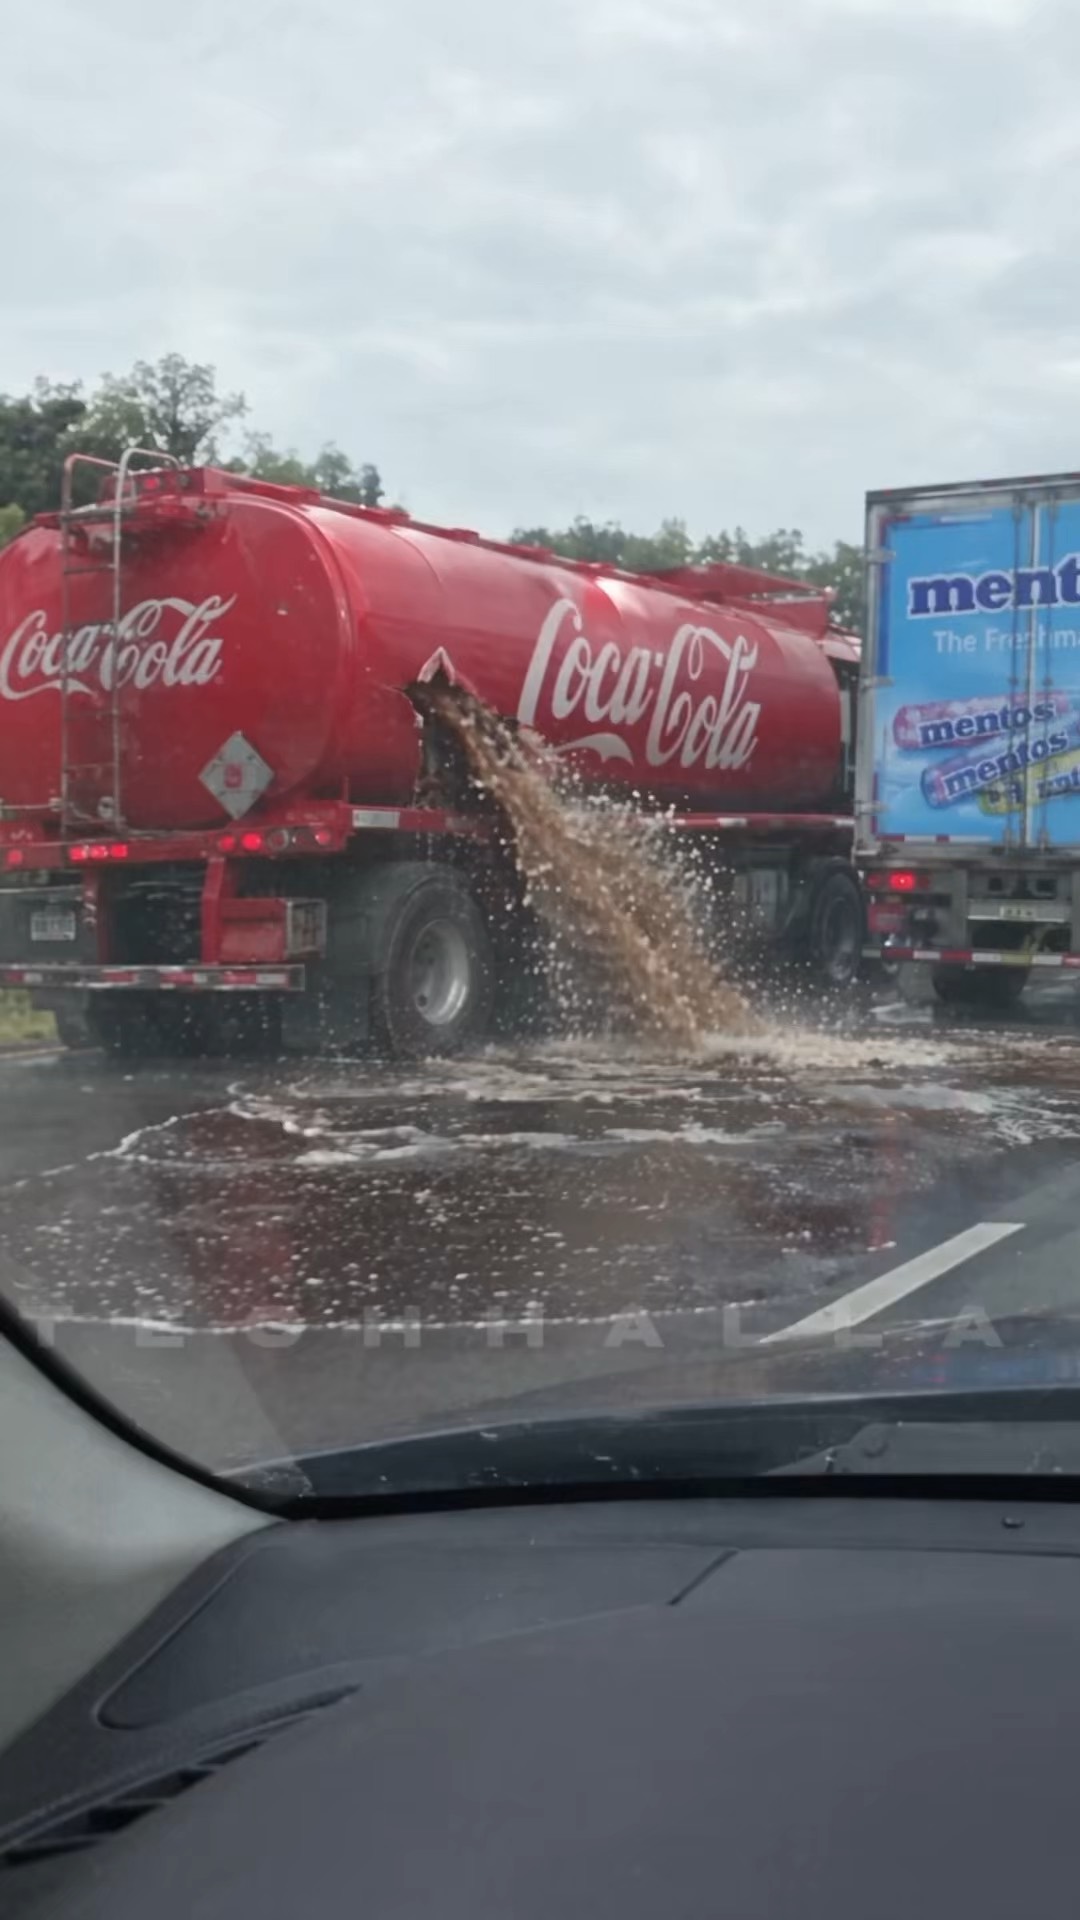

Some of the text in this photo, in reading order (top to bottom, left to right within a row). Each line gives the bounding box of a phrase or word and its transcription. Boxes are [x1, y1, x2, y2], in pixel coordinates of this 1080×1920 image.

[933, 630, 977, 653] The
[918, 702, 1055, 746] mentos
[942, 730, 1068, 798] mentos
